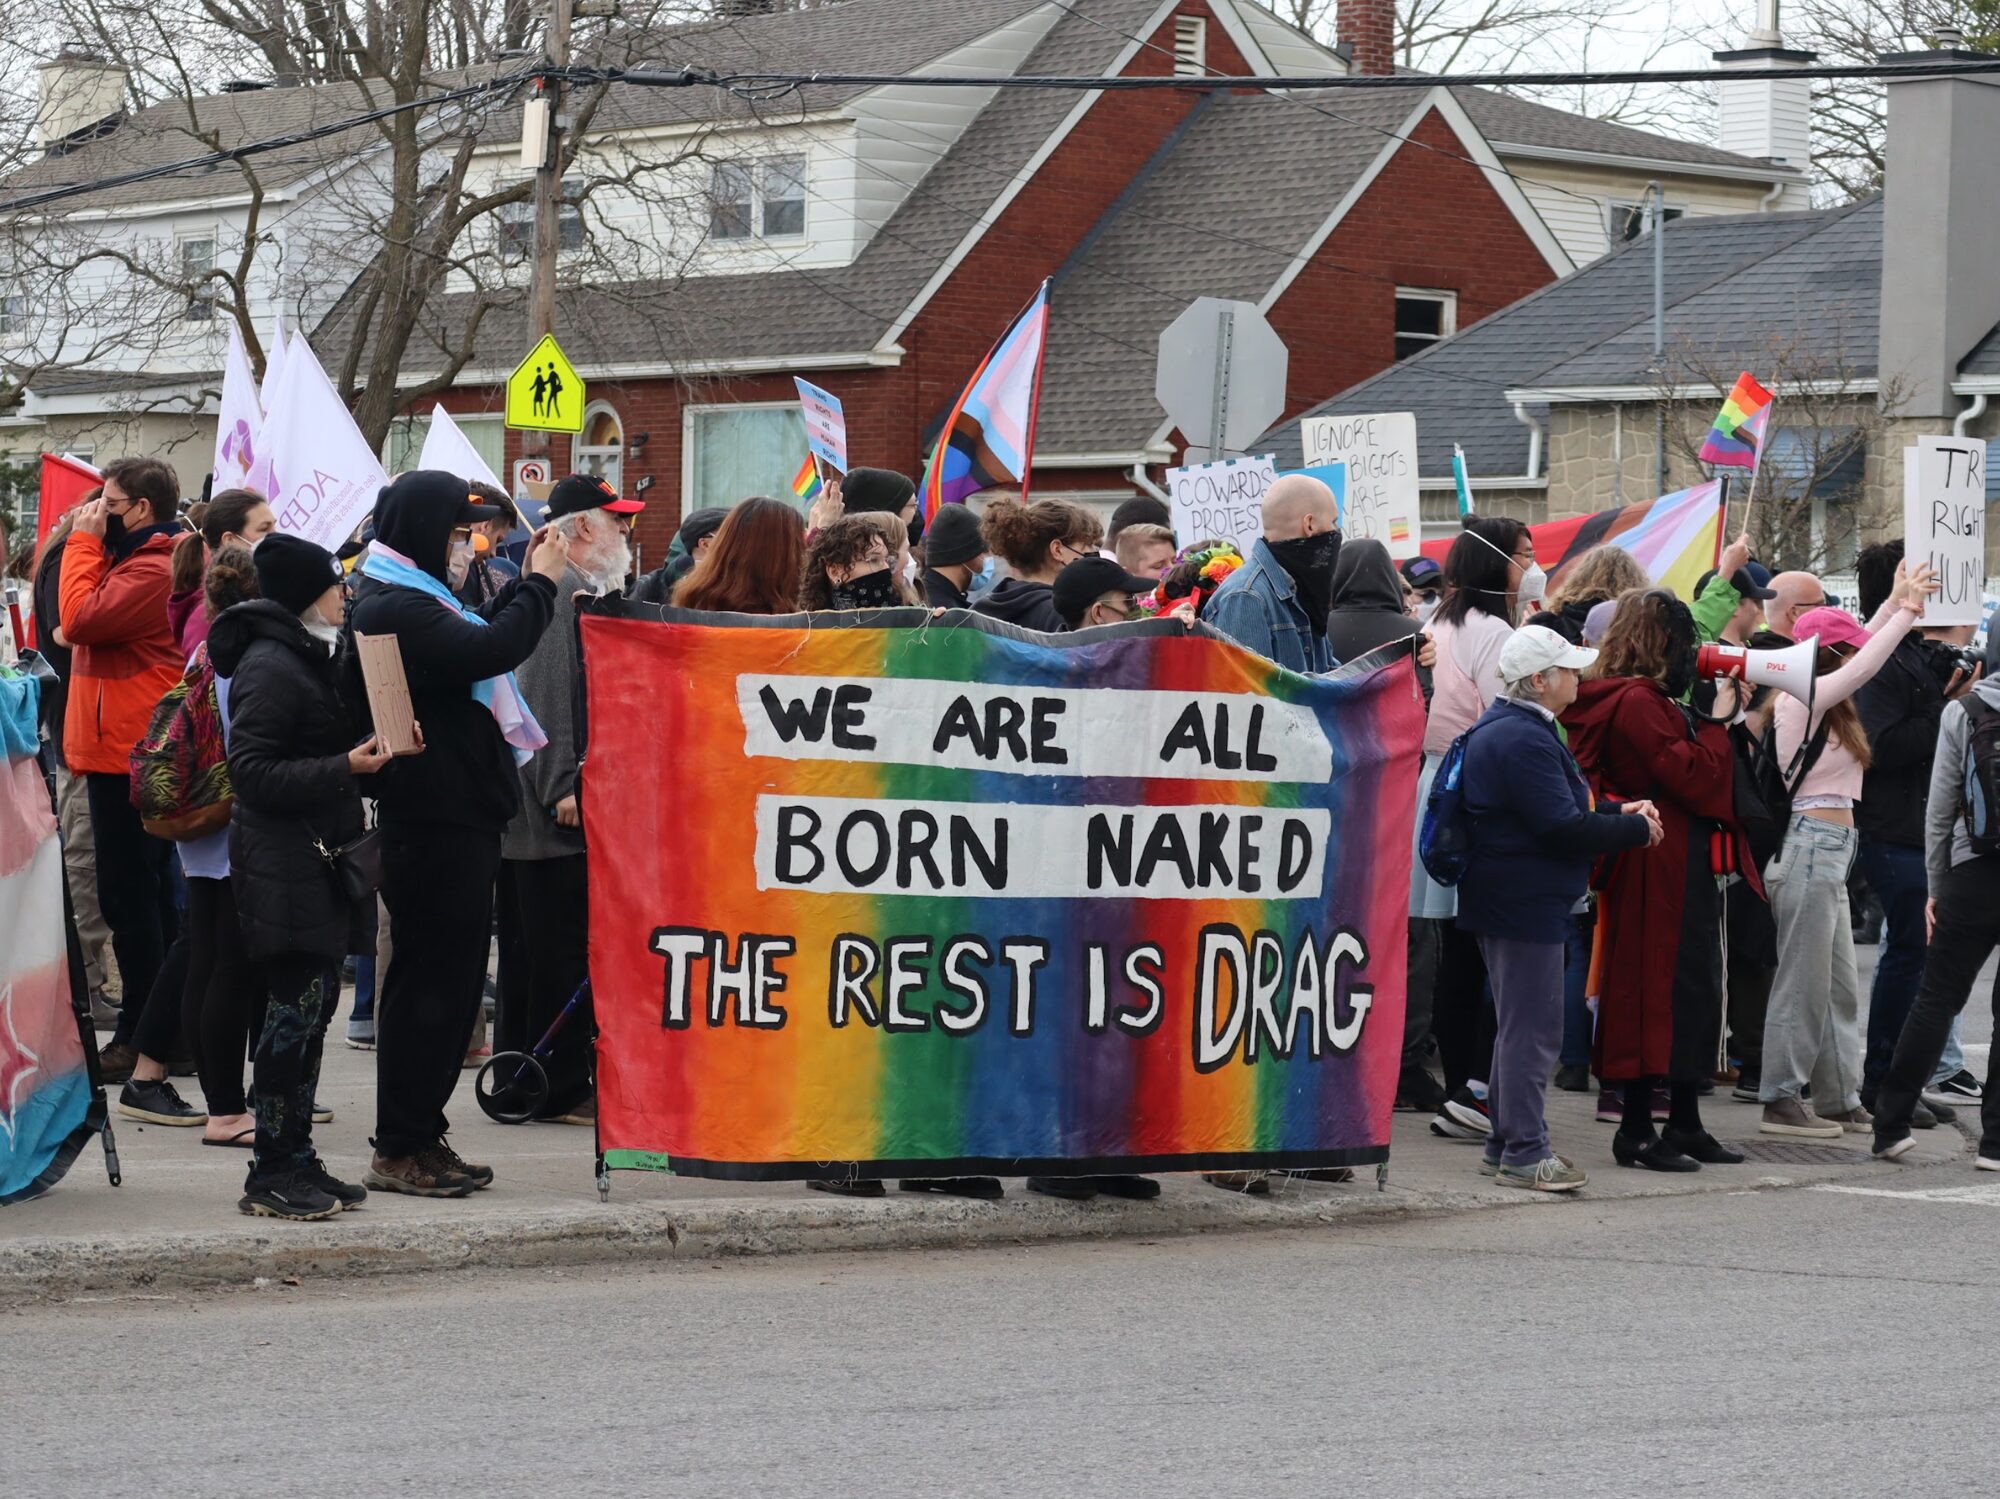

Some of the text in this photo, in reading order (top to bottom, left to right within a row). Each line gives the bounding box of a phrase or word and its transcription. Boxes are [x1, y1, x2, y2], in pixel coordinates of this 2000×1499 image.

[1312, 418, 1379, 453] IGNORE
[1350, 450, 1407, 482] BIGOTS
[1178, 466, 1273, 508] COWARDS
[1350, 485, 1389, 517] ARE
[1192, 503, 1262, 542] PROTES
[1766, 662, 1788, 672] PYLE
[758, 683, 1278, 772] WE ARE ALL
[775, 805, 1313, 894] BORN NAKED
[649, 921, 1375, 1075] THE REST IS DRAG
